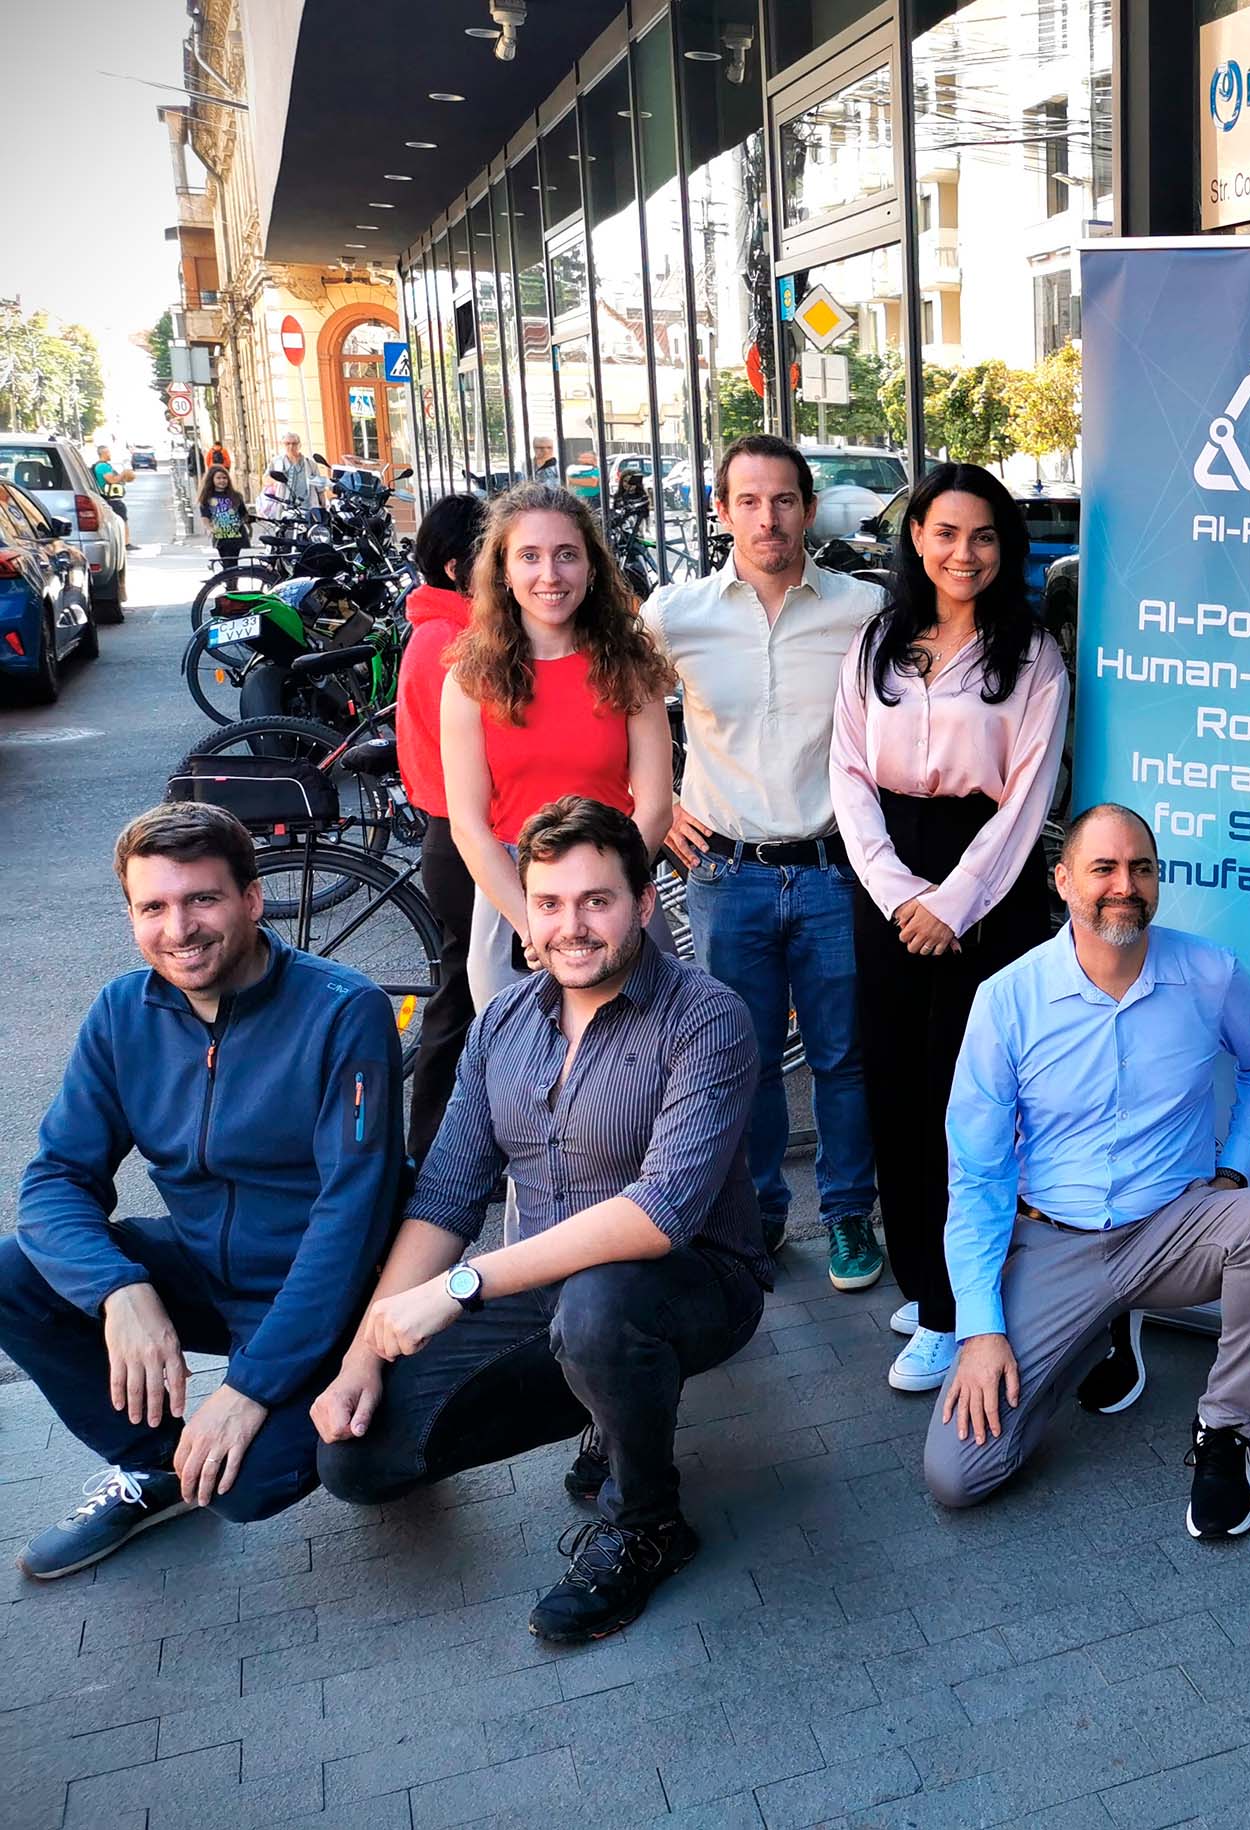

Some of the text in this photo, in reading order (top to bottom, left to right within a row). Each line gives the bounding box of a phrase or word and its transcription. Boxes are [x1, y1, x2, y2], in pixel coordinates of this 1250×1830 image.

[1210, 179, 1231, 204] Str.
[174, 400, 187, 411] 30
[220, 616, 257, 632] CJ 33
[226, 627, 252, 640] VYV
[1154, 801, 1216, 838] for
